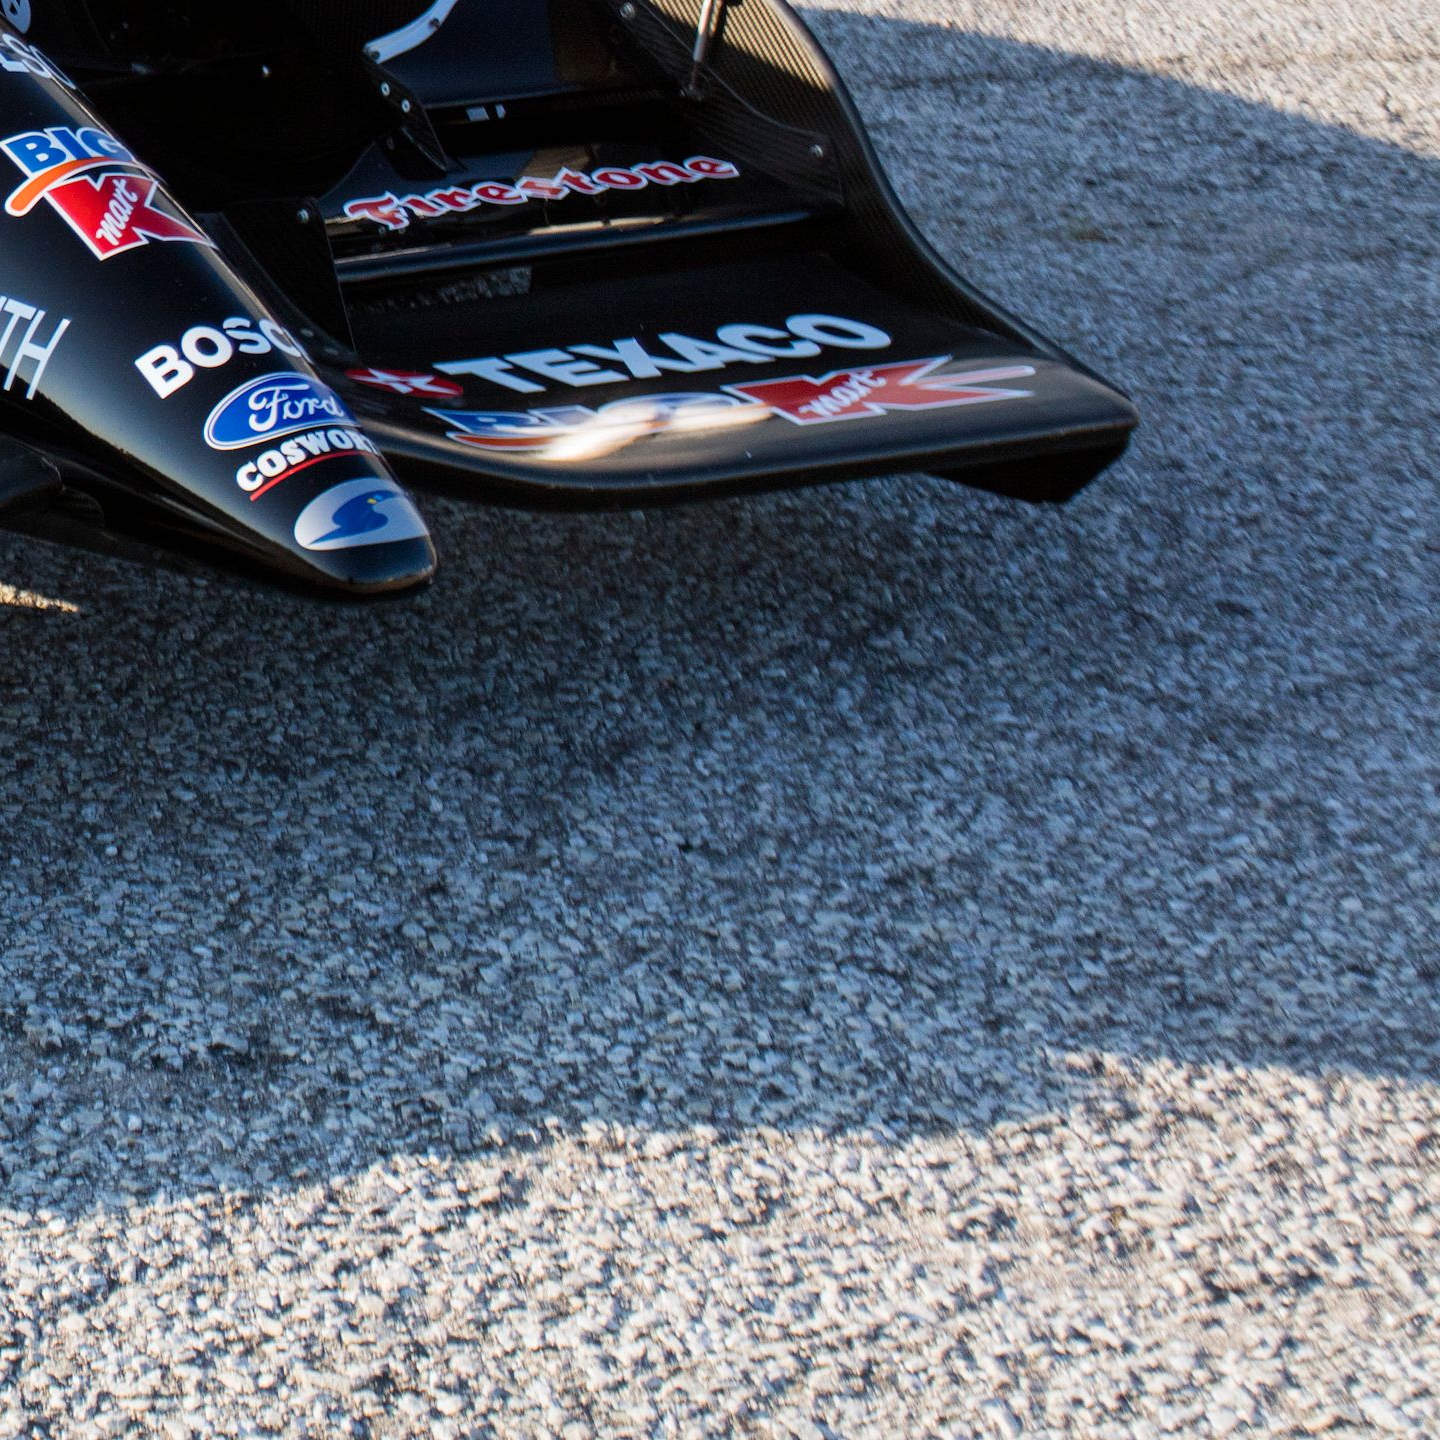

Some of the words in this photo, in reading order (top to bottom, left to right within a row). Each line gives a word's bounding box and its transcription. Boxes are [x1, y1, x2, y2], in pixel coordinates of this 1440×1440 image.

[95, 178, 139, 247] mart
[343, 153, 740, 232] Firestone
[134, 316, 305, 400] BOSC
[432, 312, 893, 396] TEXACO
[248, 382, 345, 433] Ford
[799, 368, 889, 421] mart
